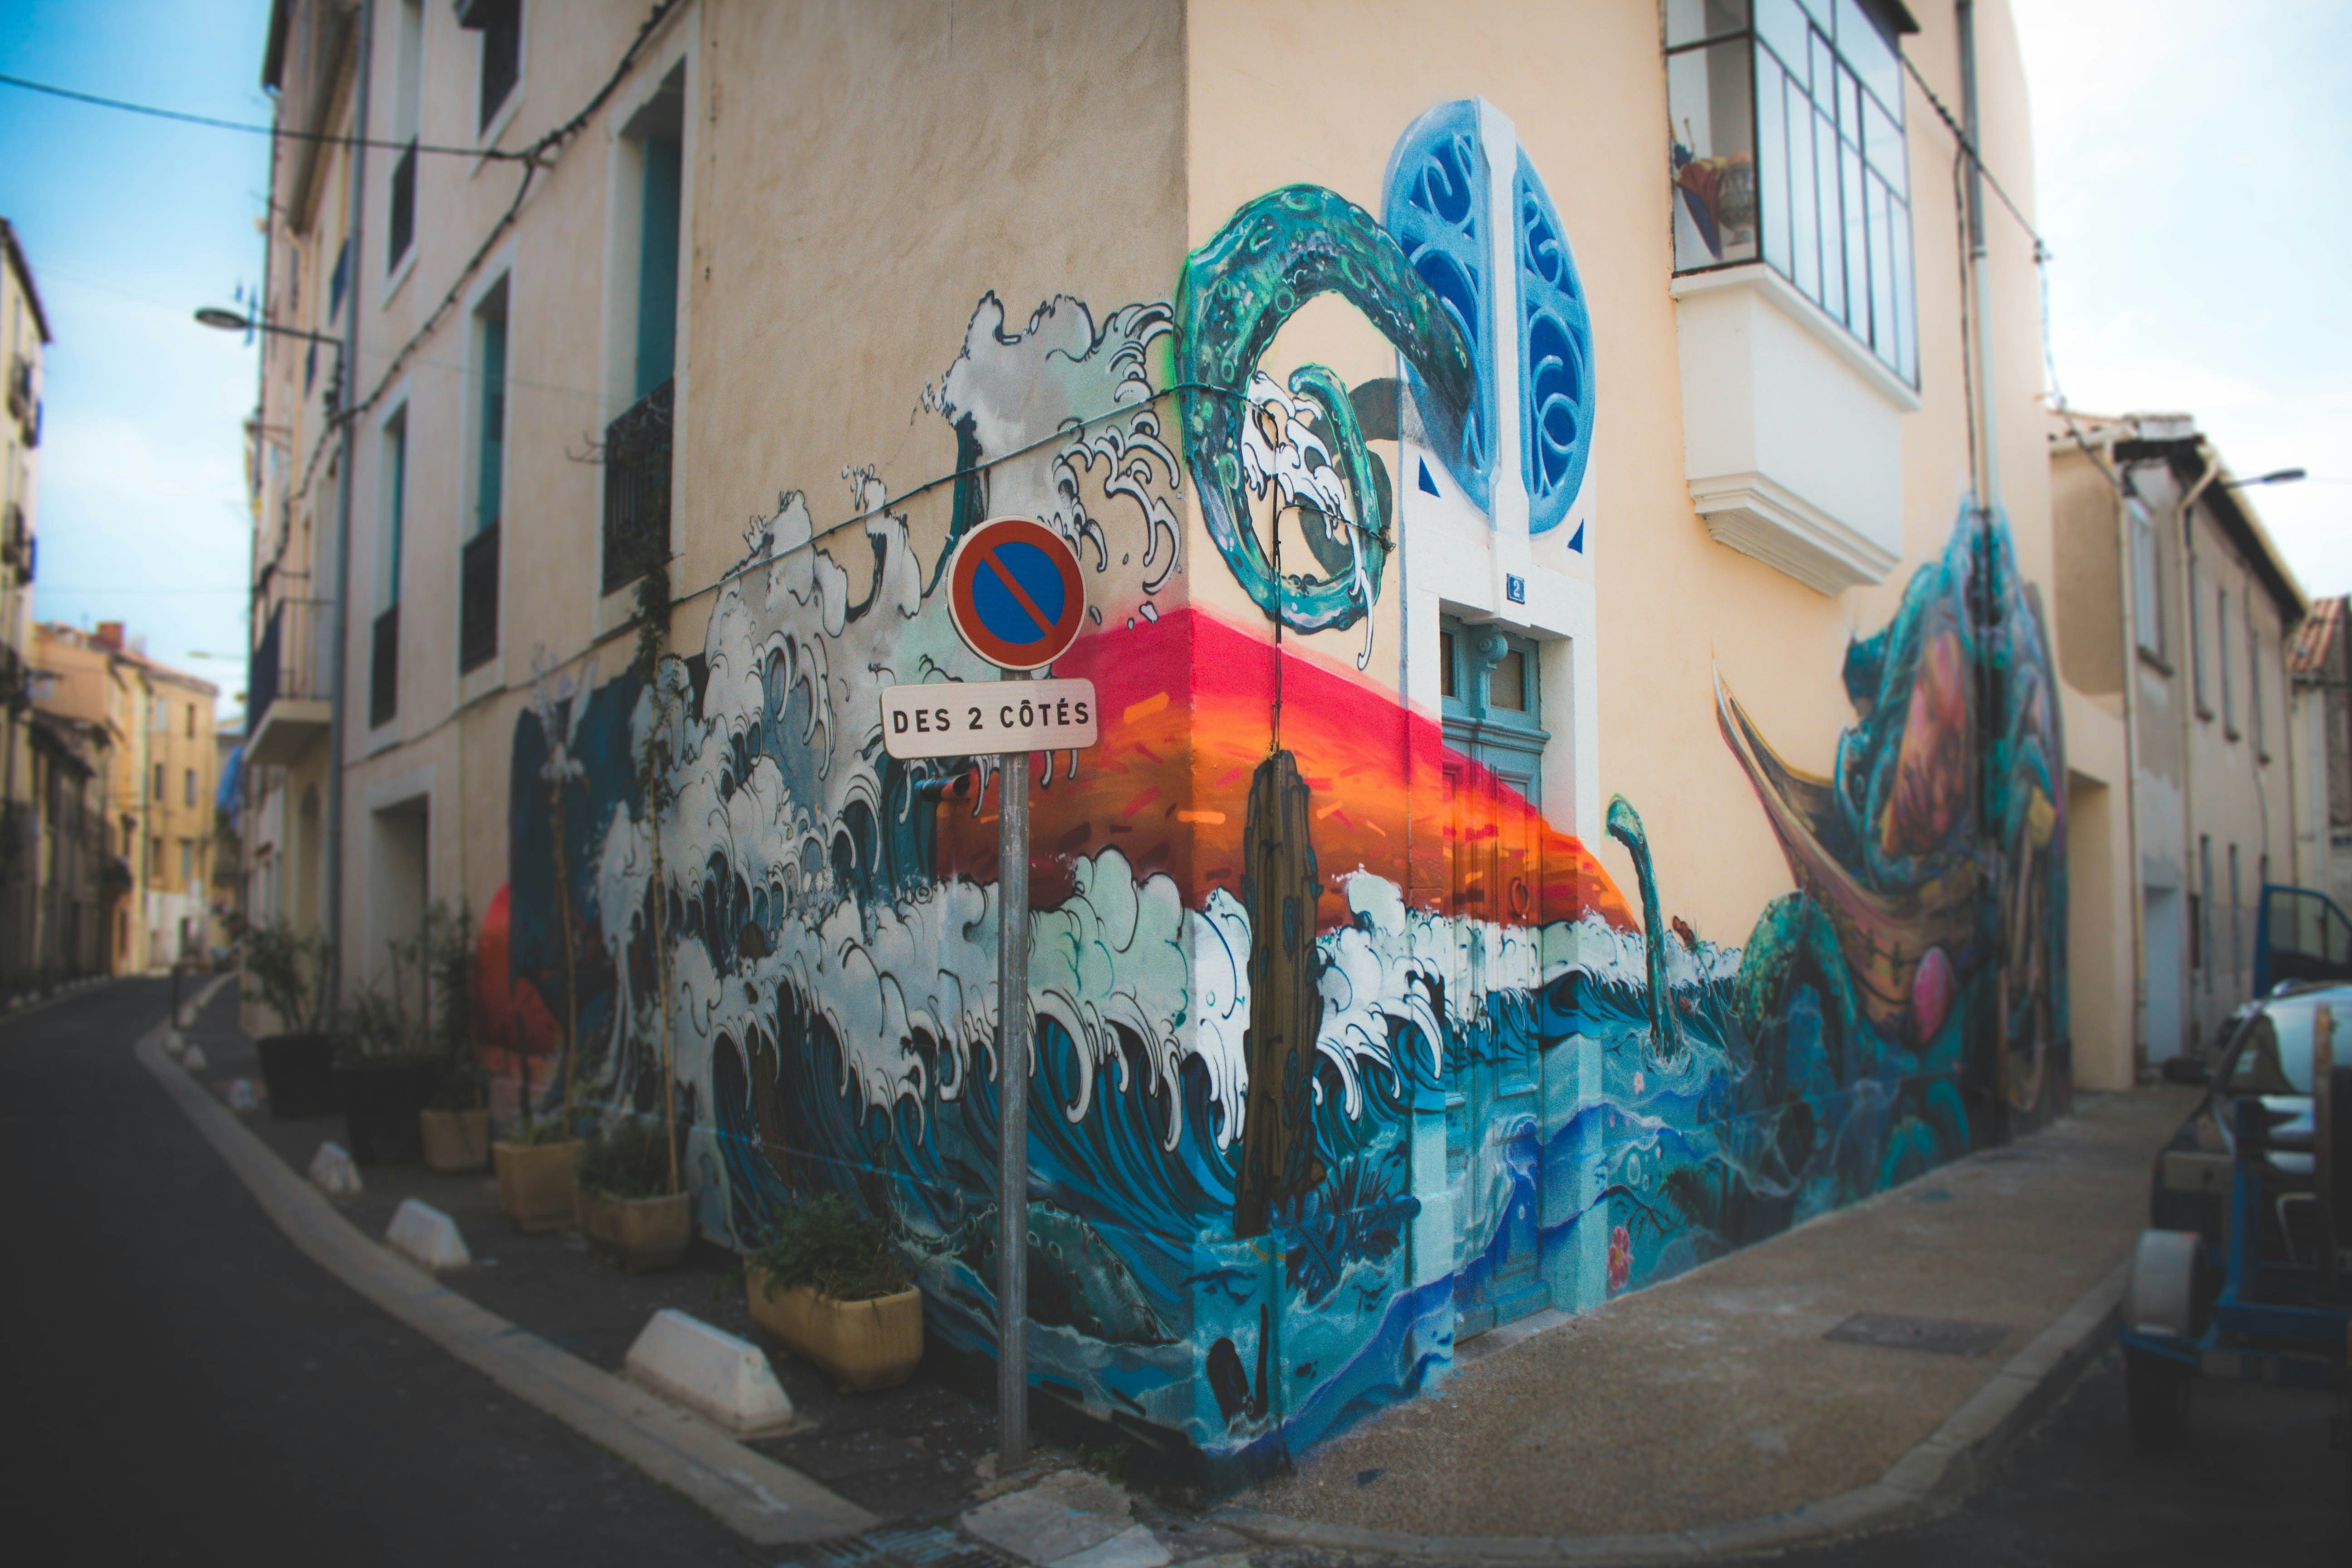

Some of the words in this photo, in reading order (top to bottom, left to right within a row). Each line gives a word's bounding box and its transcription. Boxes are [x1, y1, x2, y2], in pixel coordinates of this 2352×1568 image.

[1514, 579, 1520, 597] 2
[892, 709, 951, 734] DES
[967, 707, 984, 730] 2
[1000, 698, 1089, 728] CÔTÉS
